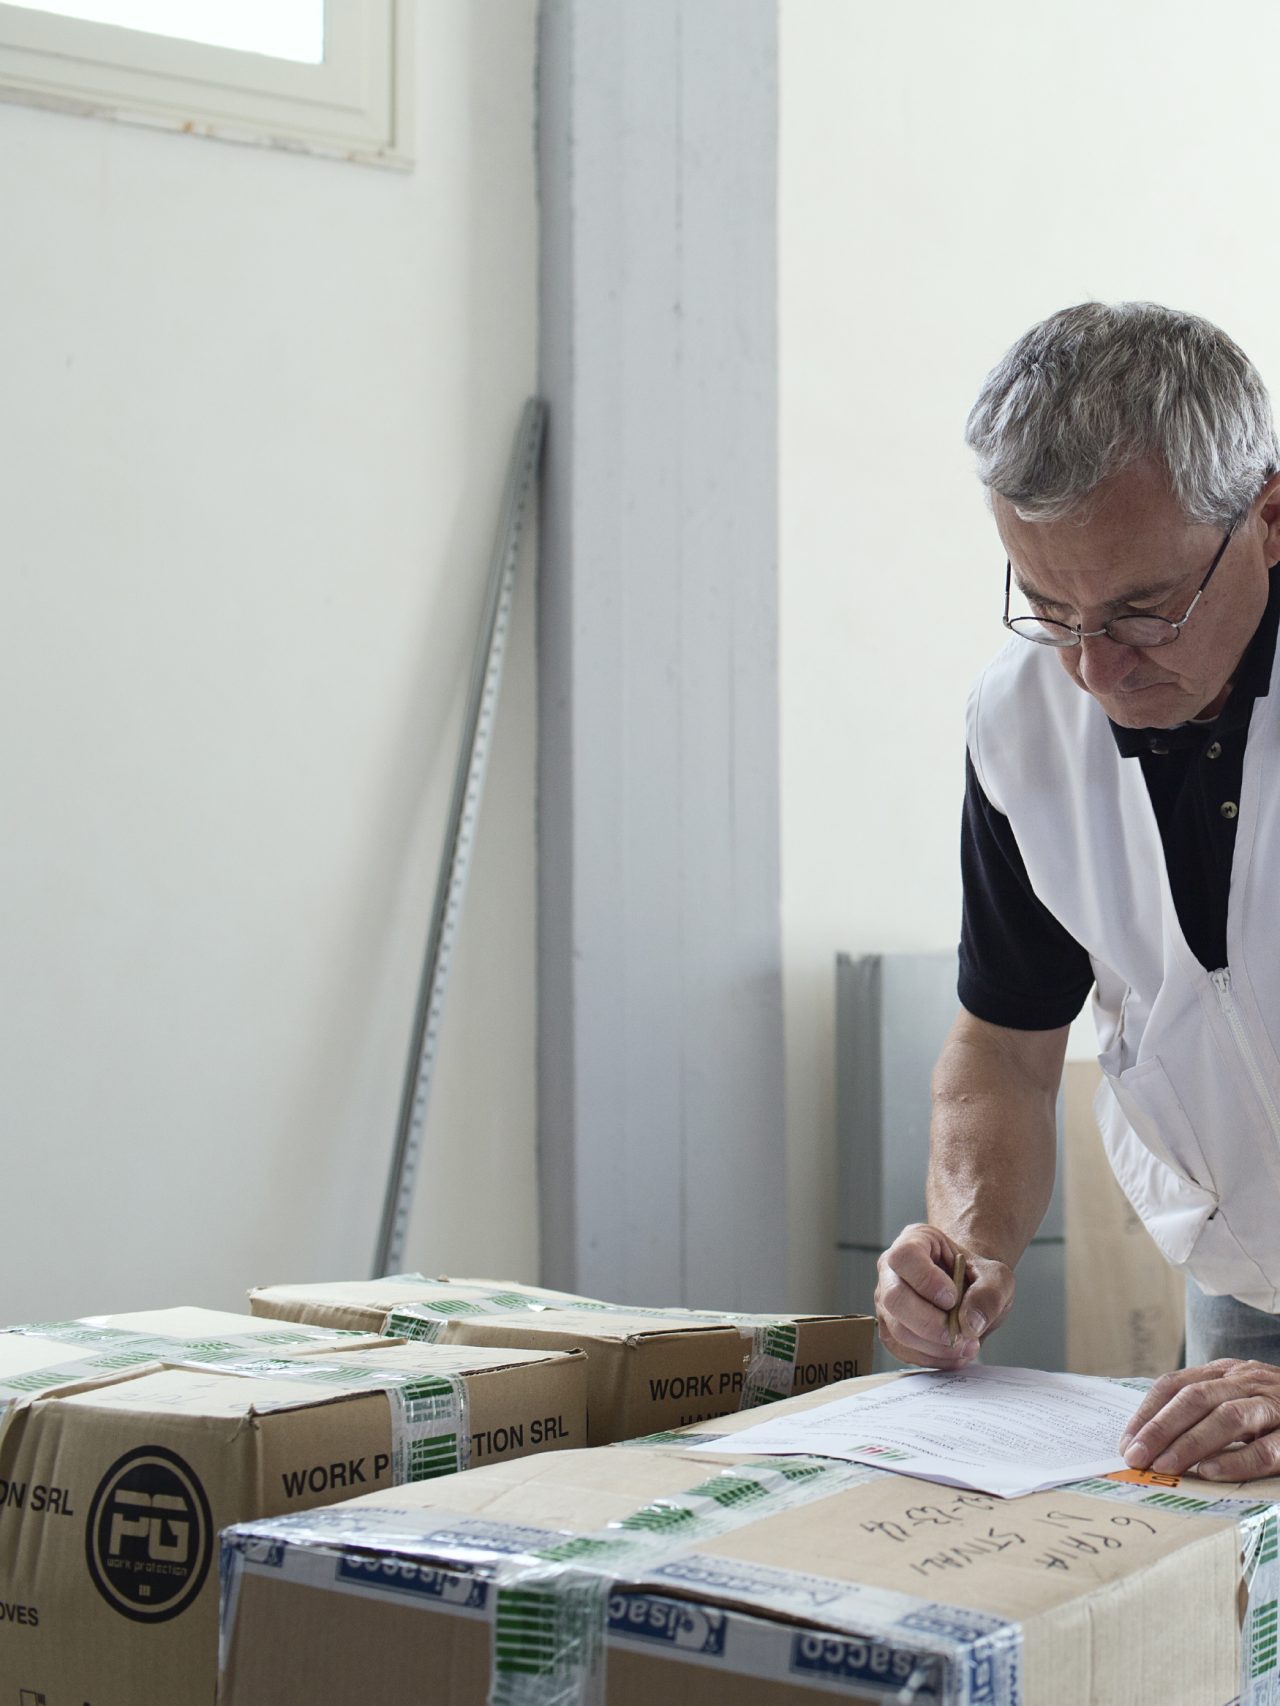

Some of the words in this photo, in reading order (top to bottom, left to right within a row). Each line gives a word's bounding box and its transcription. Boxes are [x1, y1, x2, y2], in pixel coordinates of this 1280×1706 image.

[649, 1375, 713, 1401] WORK
[833, 1360, 862, 1380] SRL
[282, 1458, 366, 1498] WORK
[530, 1415, 569, 1444] SRL
[31, 1485, 74, 1516] SRL
[107, 1558, 132, 1573] work
[133, 1561, 188, 1577] protection
